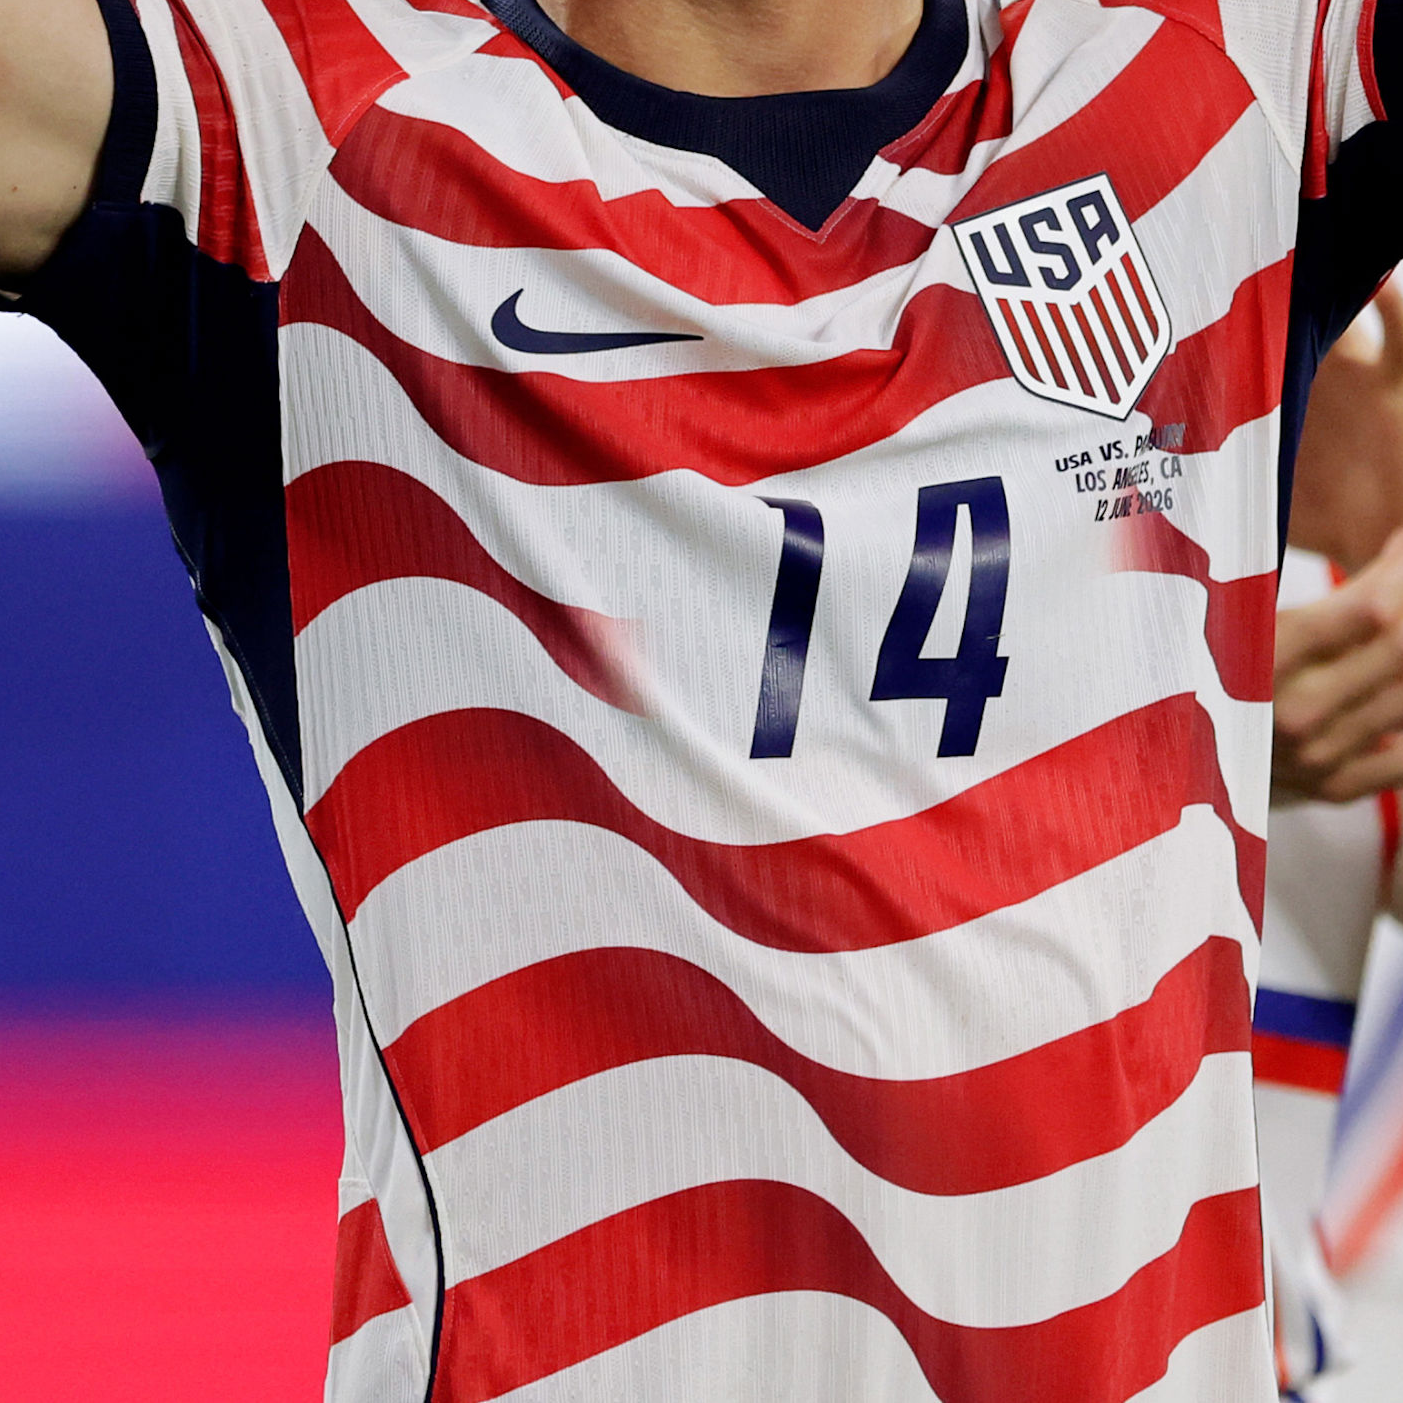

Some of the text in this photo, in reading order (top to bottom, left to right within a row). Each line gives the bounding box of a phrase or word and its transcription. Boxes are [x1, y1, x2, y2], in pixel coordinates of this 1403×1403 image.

[969, 189, 1120, 291] USA
[1055, 451, 1092, 472] USA
[1099, 440, 1128, 462] VS.
[1075, 469, 1106, 492] LOS
[1160, 456, 1182, 479] CA
[1094, 488, 1173, 522] 12 JUNE 2026
[749, 475, 1011, 759] 14
